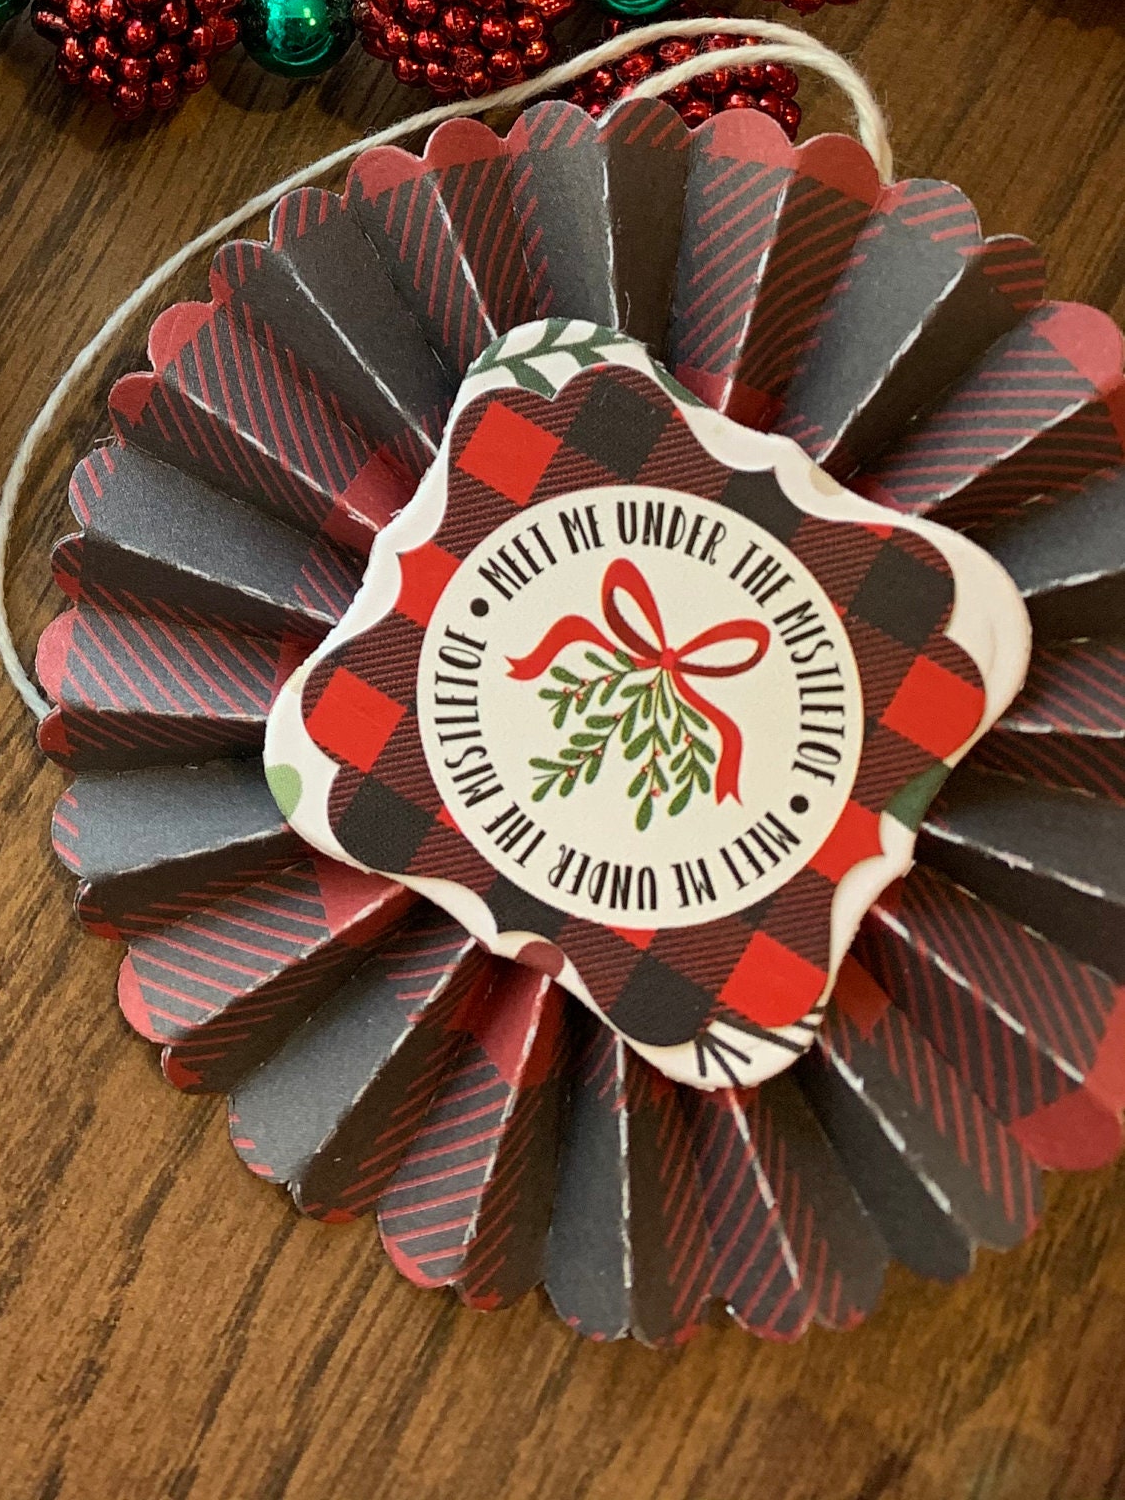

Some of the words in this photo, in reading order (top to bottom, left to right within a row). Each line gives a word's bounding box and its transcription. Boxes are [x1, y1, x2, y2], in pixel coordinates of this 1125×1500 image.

[477, 522, 558, 601] MEET
[558, 504, 605, 555] ME
[616, 501, 728, 566] UNDER
[728, 540, 796, 608] THE
[773, 599, 846, 786] MISTLETOE
[434, 624, 504, 809] MISTLETOE
[481, 801, 546, 867] THE
[731, 810, 803, 893] MEET
[548, 843, 658, 911] UNDER
[671, 857, 718, 909] ME
